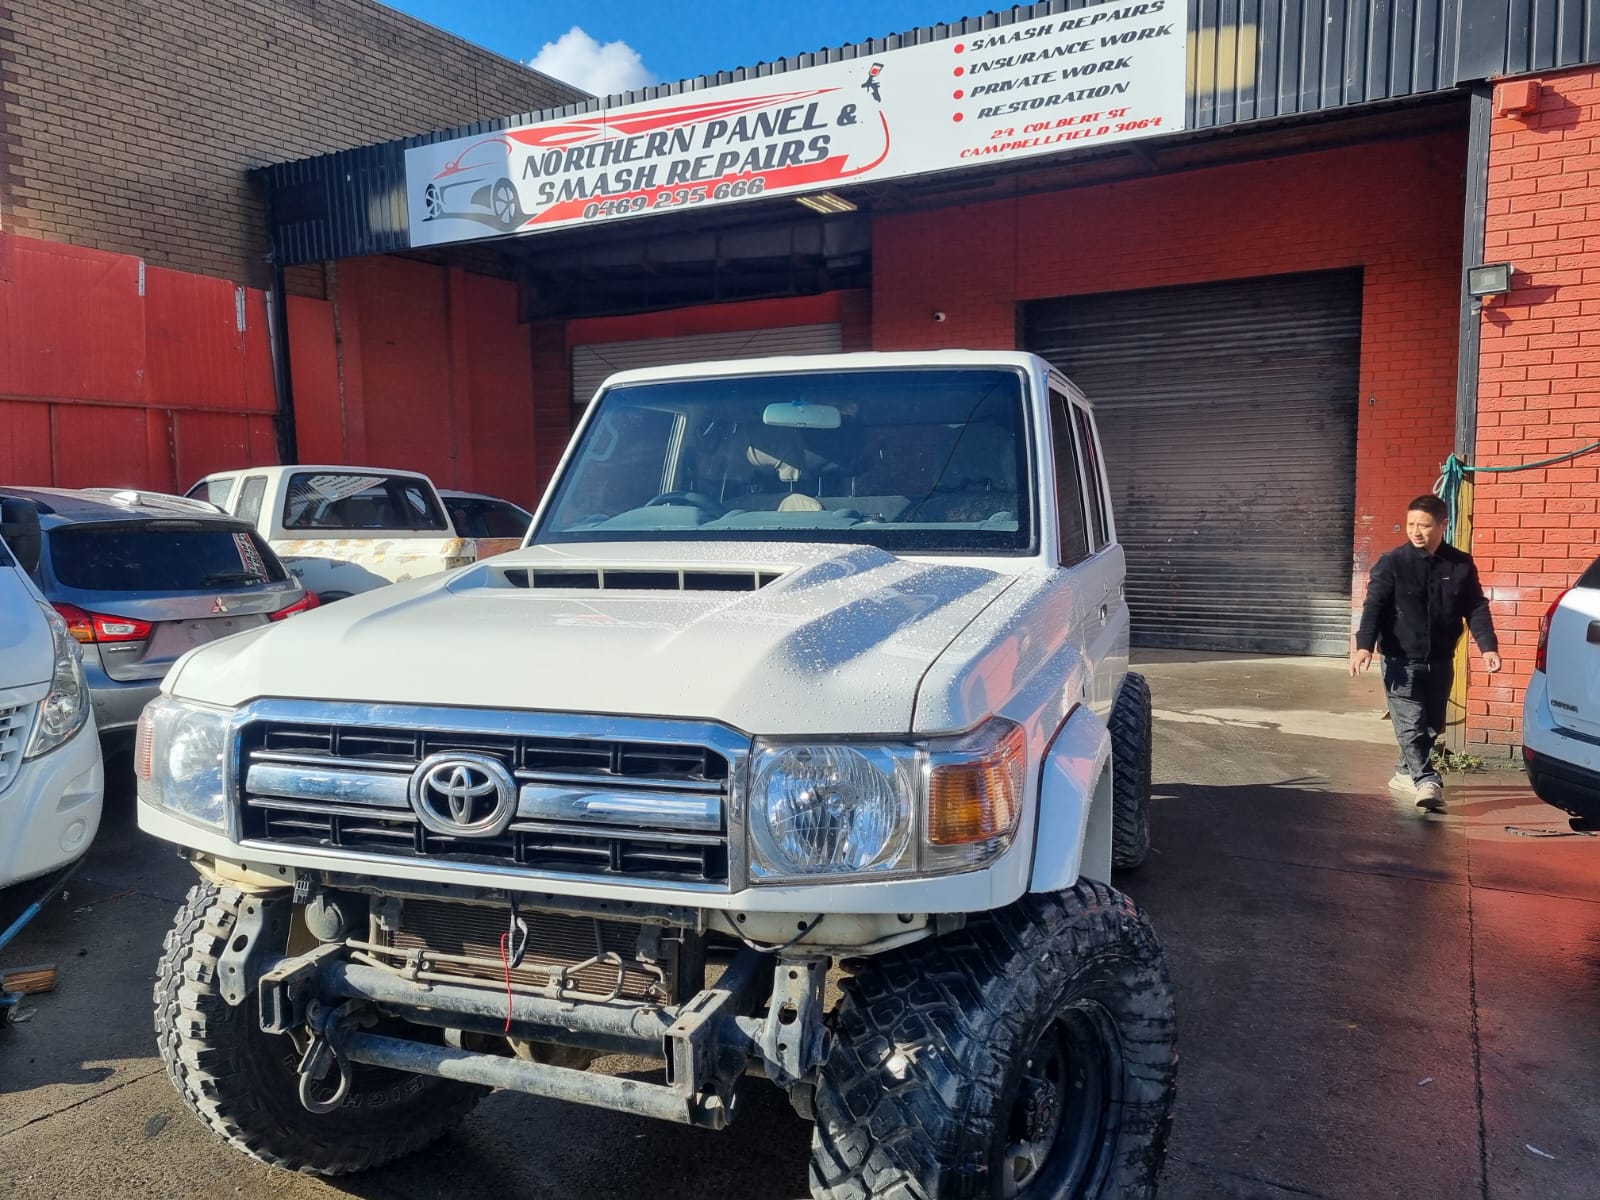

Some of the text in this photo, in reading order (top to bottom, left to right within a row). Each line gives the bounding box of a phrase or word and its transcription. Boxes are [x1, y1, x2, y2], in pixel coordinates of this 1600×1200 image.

[969, 0, 1166, 52] SMASH REPAIRS
[969, 23, 1175, 75] INSURANCE WORK
[969, 55, 1134, 98] PRIVATE WORK
[977, 81, 1131, 120] RESTORATION
[522, 102, 858, 180] NORTHERN PANEL &
[959, 116, 1163, 158] CAMPBELLFIELD 3064
[990, 106, 1133, 140] 24 COLBERT ST
[536, 134, 831, 206] SMASH REPAIRS
[583, 177, 766, 220] 0469 235 666
